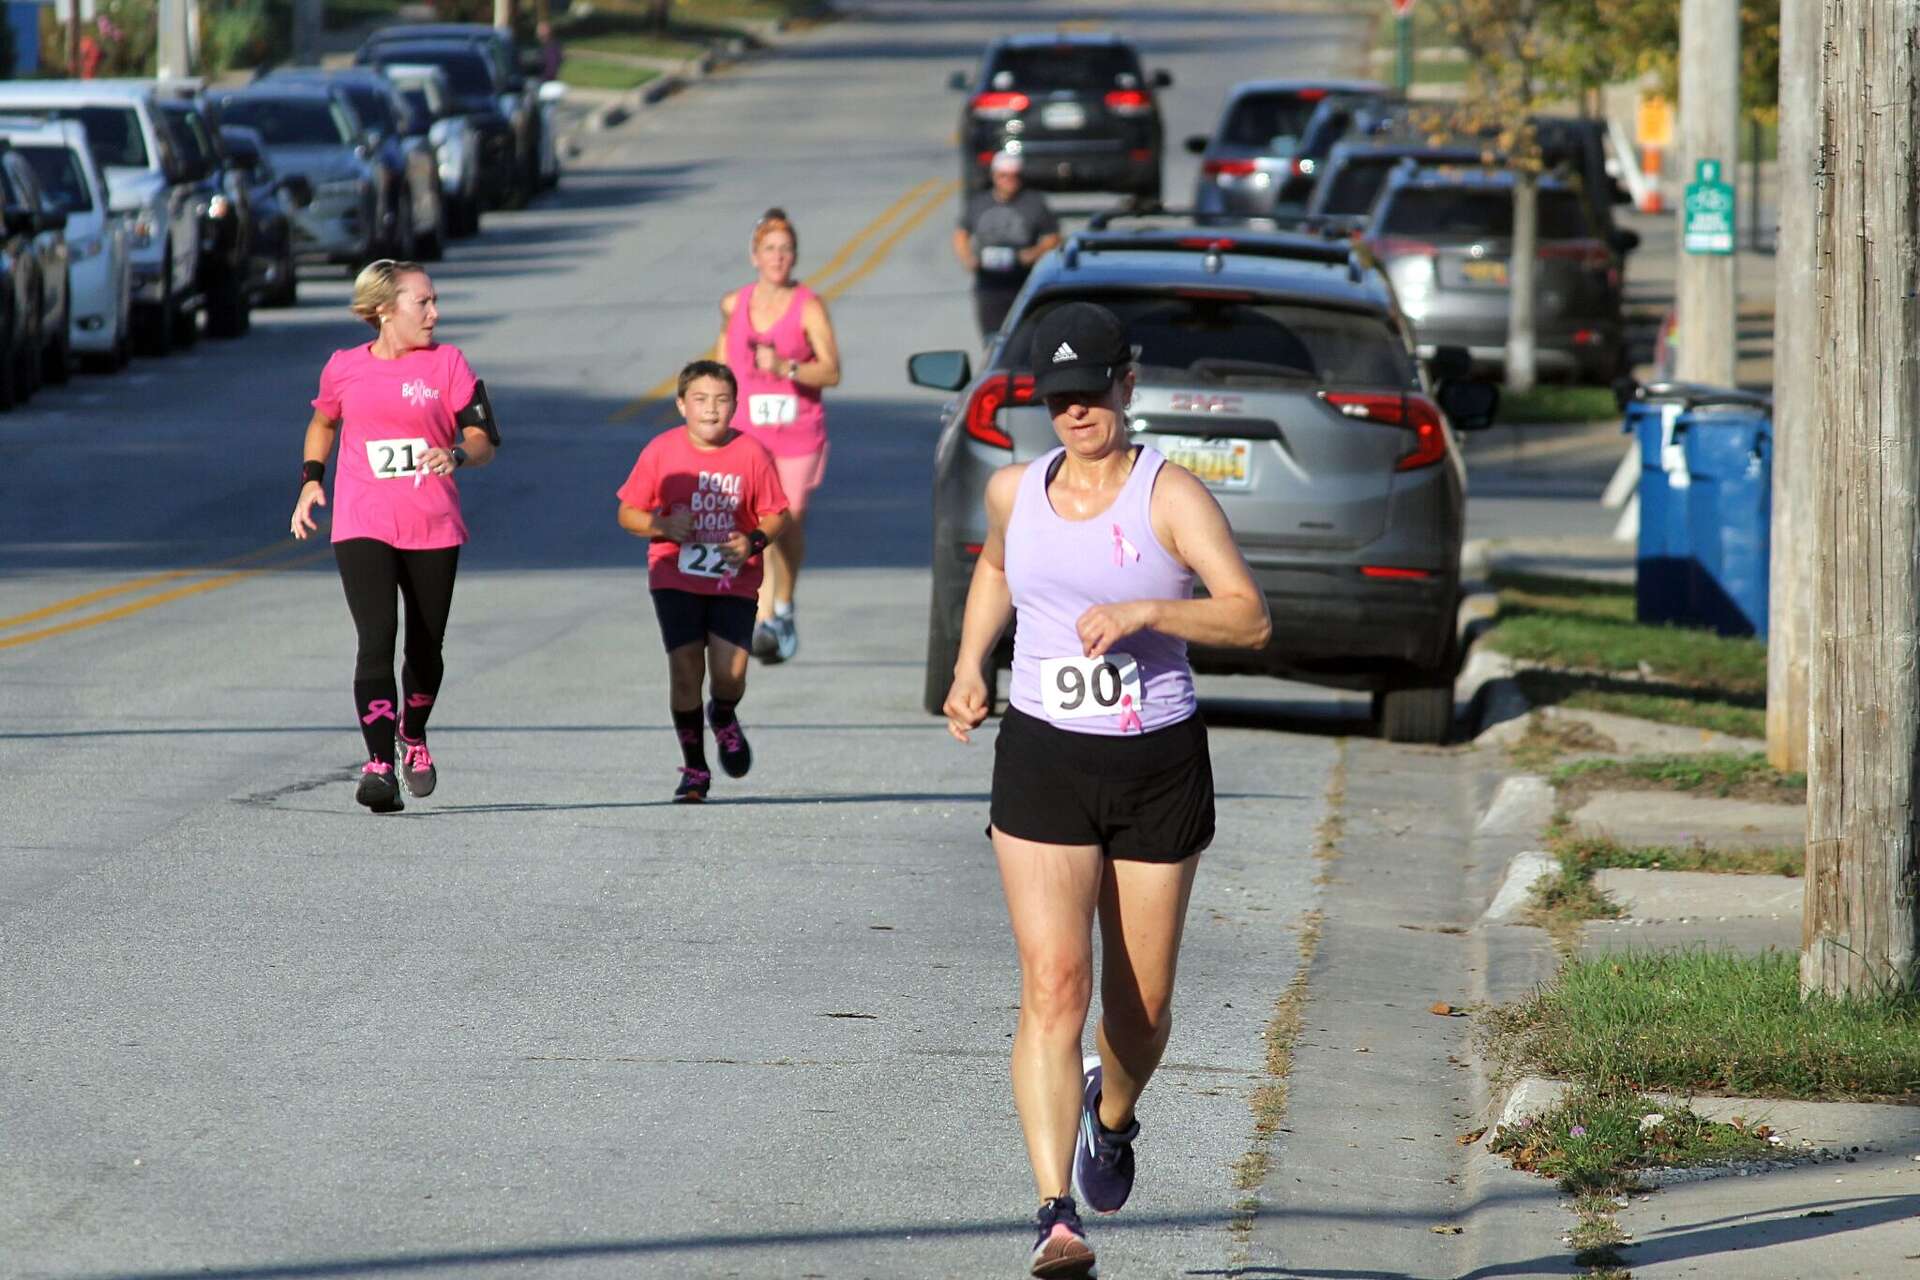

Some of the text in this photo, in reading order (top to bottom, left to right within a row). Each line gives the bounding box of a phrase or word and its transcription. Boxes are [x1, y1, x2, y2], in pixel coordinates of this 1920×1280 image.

[758, 399, 788, 423] 47
[378, 444, 416, 473] 21
[1056, 662, 1122, 710] 90
